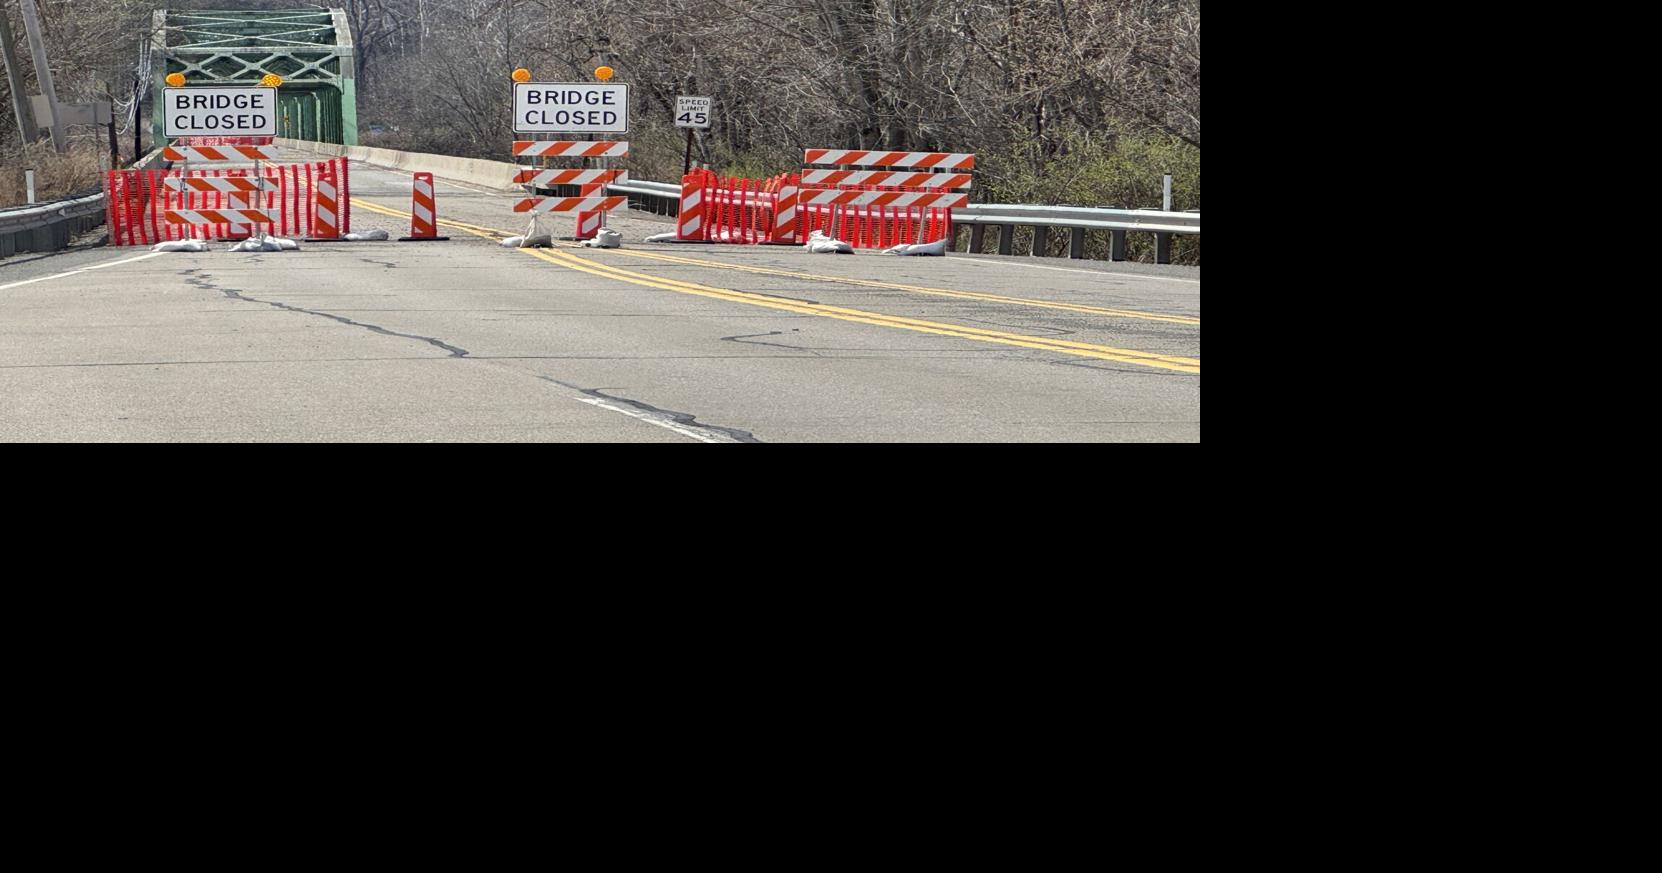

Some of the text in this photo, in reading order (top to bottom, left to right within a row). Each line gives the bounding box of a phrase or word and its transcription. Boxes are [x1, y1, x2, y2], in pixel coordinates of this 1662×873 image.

[175, 94, 265, 109] BRIDGE
[527, 90, 616, 105] BRIDGE
[678, 98, 709, 106] SPEED
[174, 114, 267, 130] CLOSED
[525, 110, 617, 126] CLOSED
[676, 112, 707, 124] 45
